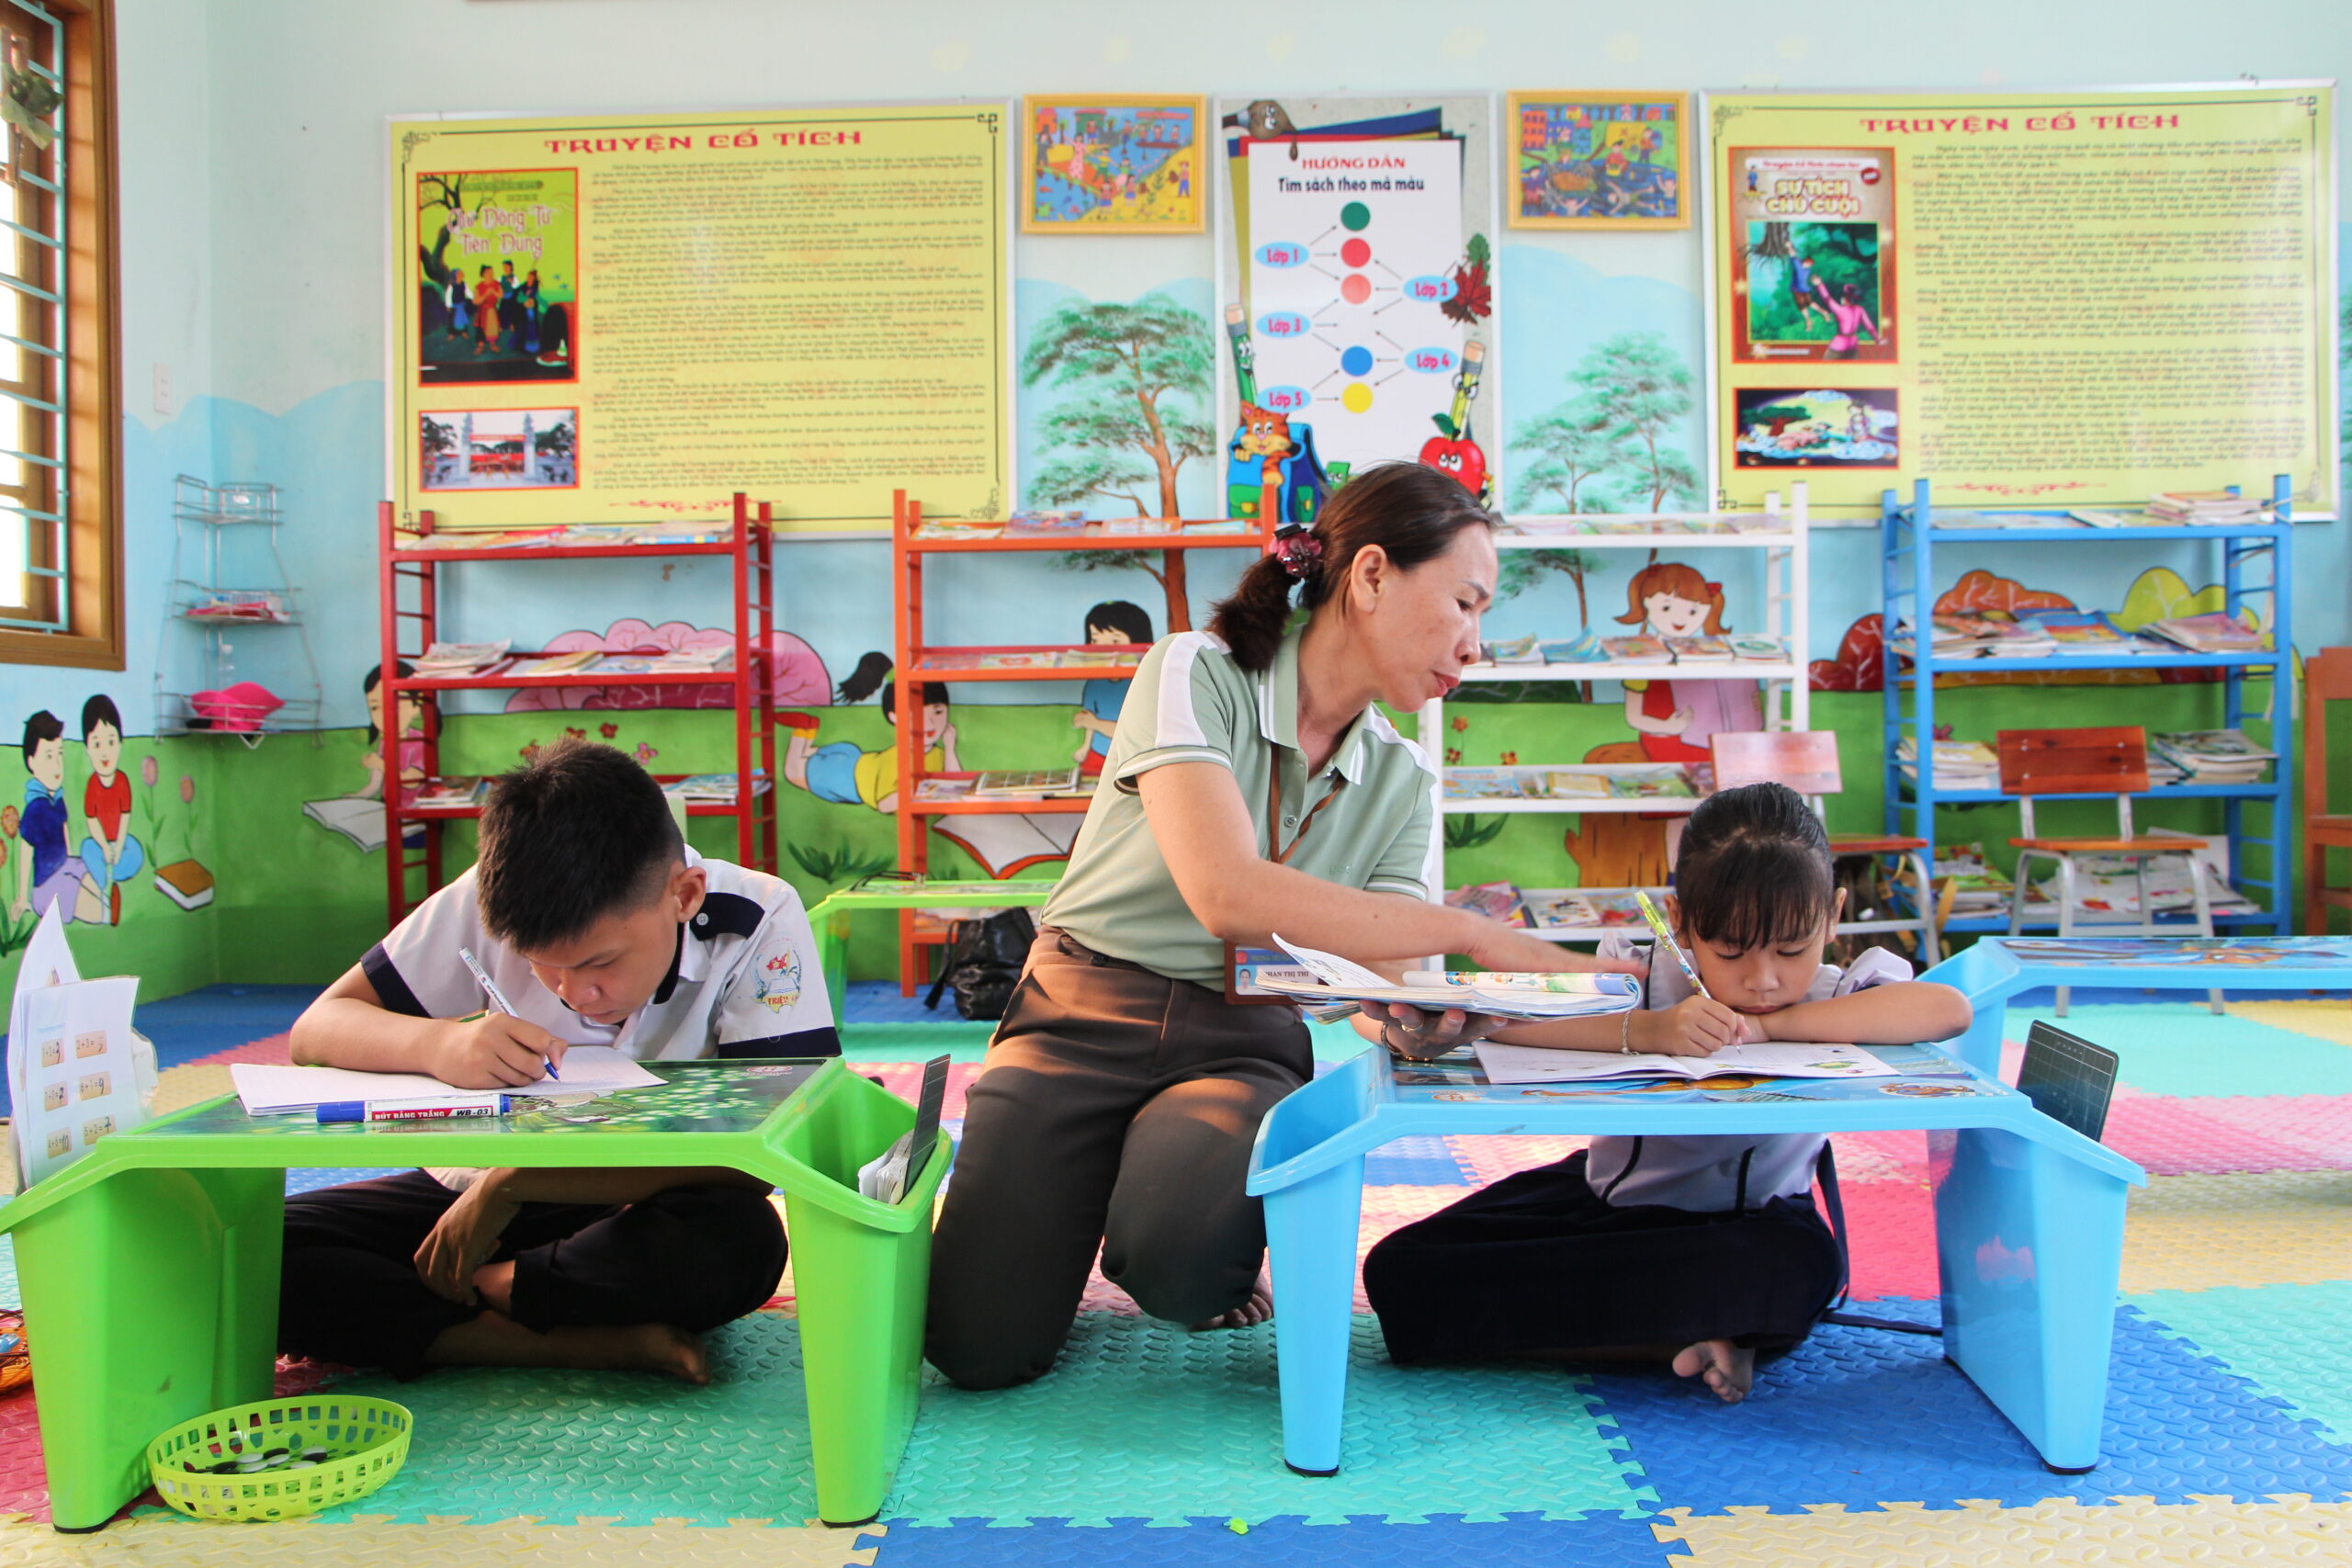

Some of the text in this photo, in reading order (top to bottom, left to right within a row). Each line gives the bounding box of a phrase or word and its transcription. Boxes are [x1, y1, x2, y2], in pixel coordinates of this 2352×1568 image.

[1860, 116, 2009, 134] TRUYỆN
[2090, 113, 2179, 130] TÍCH
[544, 134, 692, 154] TRUYỆN
[773, 130, 861, 147] TÍCH
[1306, 176, 1334, 192] sách
[1338, 175, 1367, 191] theo
[1293, 248, 1299, 261] 1
[1441, 281, 1449, 297] 2
[1295, 318, 1302, 332] 3
[1442, 354, 1451, 367] 4
[1295, 391, 1303, 406] 5
